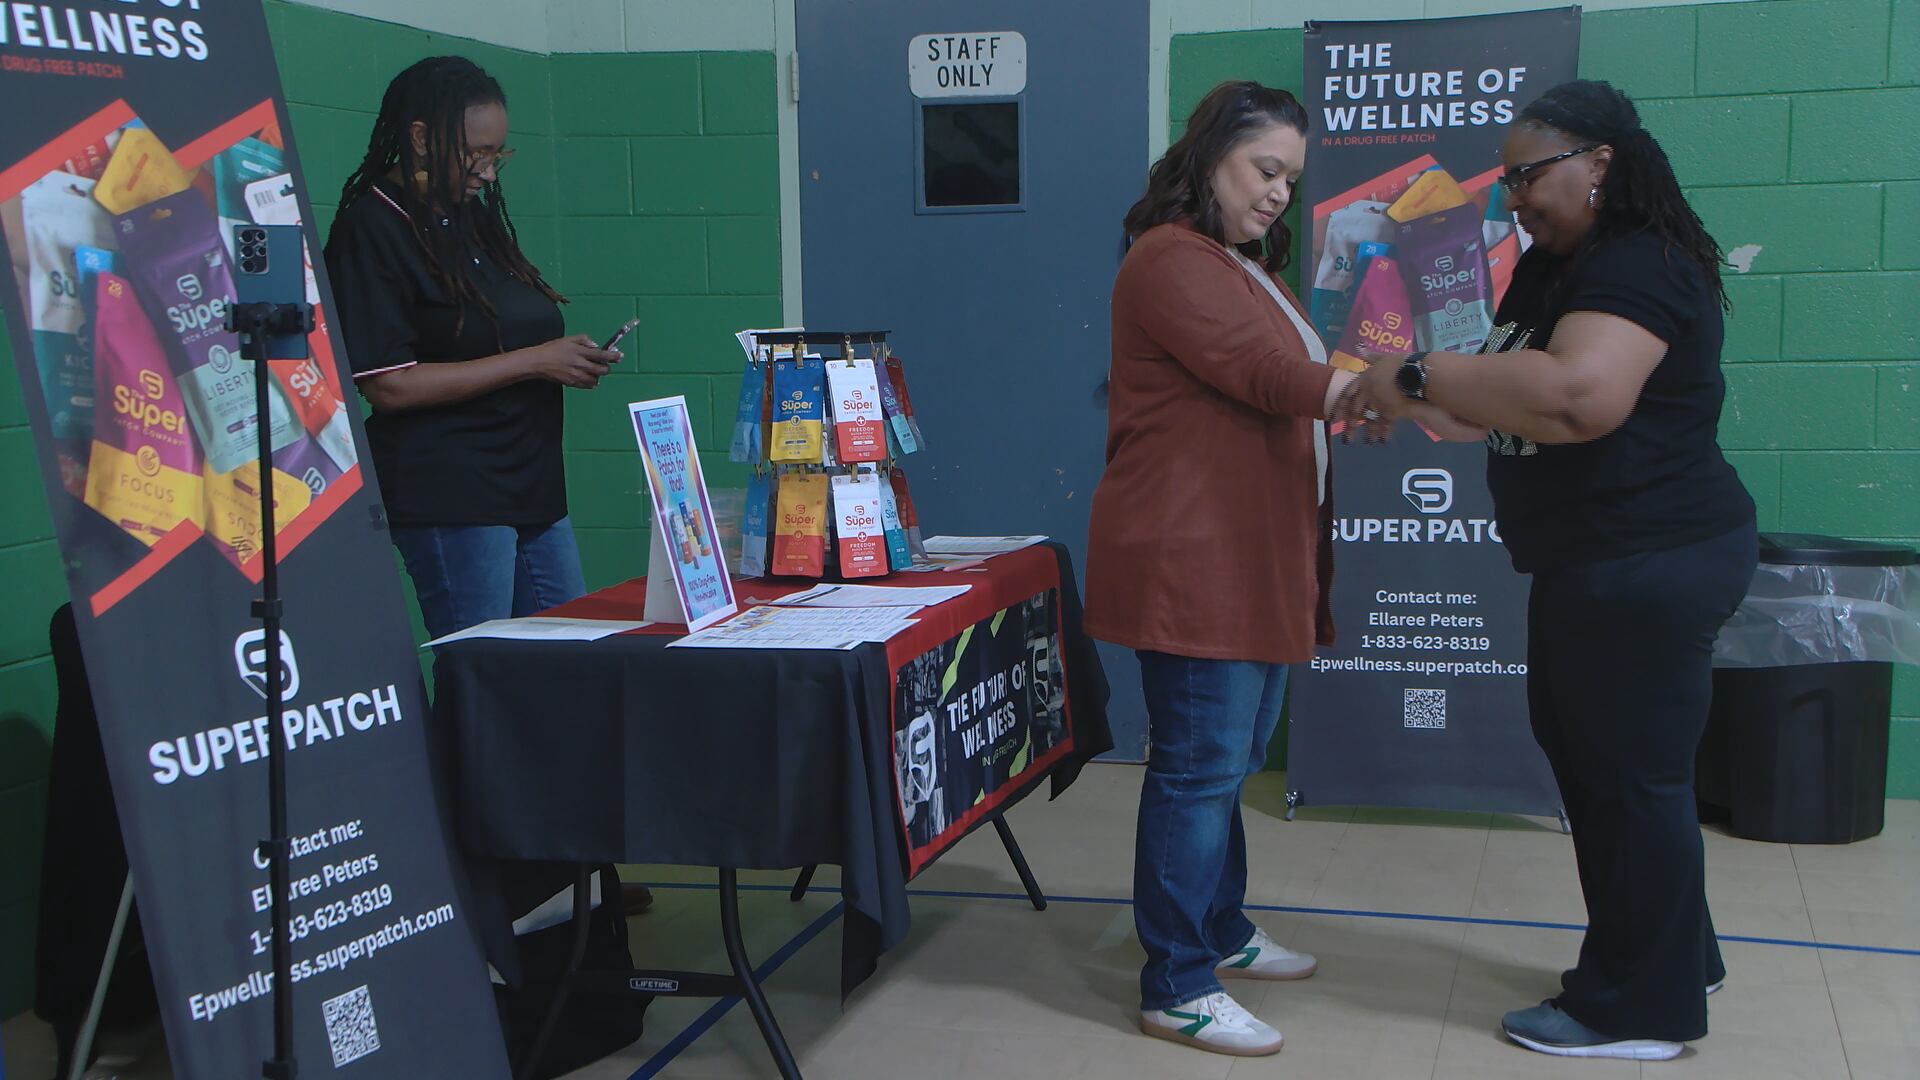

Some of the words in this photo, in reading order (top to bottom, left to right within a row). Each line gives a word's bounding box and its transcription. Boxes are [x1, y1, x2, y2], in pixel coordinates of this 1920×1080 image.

[928, 37, 1001, 61] STAFF
[1325, 43, 1392, 69] THE
[2, 55, 42, 74] DRUG
[44, 59, 76, 76] FREE
[78, 62, 123, 79] PATCH
[937, 63, 994, 88] ONLY
[1325, 70, 1463, 101] FUTURE
[1477, 67, 1526, 93] OF
[1323, 100, 1514, 131] WELLNESS
[1321, 137, 1332, 146] IN
[1334, 136, 1342, 146] A
[1344, 135, 1373, 146] DRUG
[1375, 134, 1398, 145] FREE
[1400, 133, 1436, 143] PATCH
[1366, 245, 1377, 254] 28
[1377, 260, 1389, 271] 28
[1433, 312, 1483, 332] LIBERTY
[1358, 319, 1412, 351] Super
[113, 384, 186, 435] Super
[781, 400, 812, 411] Super
[843, 400, 873, 412] Super
[652, 440, 676, 458] There's
[657, 460, 676, 476] Patch
[120, 474, 175, 503] FOCUS
[784, 514, 816, 525] Super
[845, 516, 875, 526] Super
[1427, 519, 1503, 542] PATC
[1375, 590, 1442, 604] Contact
[1446, 591, 1477, 604] me:
[1369, 612, 1426, 627] Ellaree
[1430, 613, 1484, 627] Peters
[1361, 635, 1490, 650] 1-833-623-8319
[1311, 656, 1528, 676] Epwellness.superpatch.co
[282, 684, 402, 750] PATCH
[330, 819, 364, 845] me:
[251, 870, 322, 912] Elree
[322, 853, 379, 888] Peters
[250, 883, 393, 955] 1-33-623-8319
[188, 903, 455, 1022] Epwellnss.superpatch.com
[635, 980, 673, 989] LIFETIME
